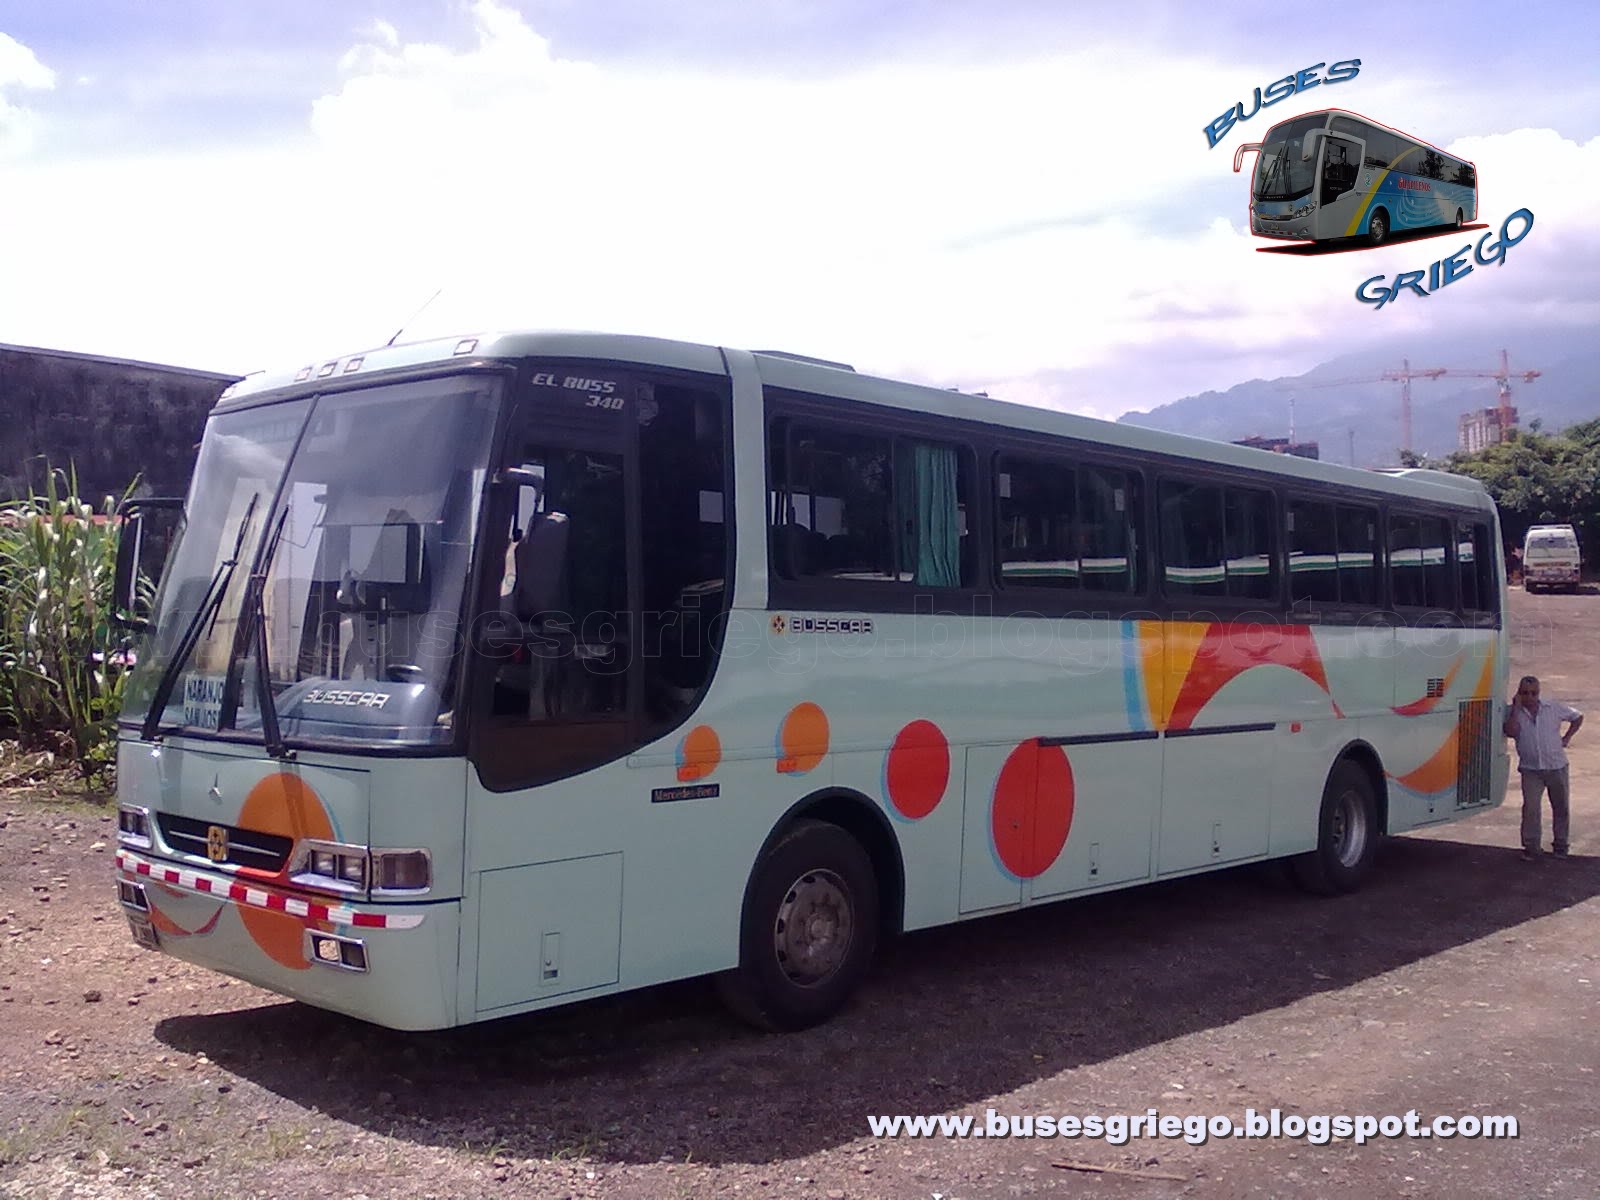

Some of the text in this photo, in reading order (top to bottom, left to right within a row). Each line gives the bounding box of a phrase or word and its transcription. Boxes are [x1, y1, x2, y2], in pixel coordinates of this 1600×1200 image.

[532, 372, 617, 393] EL BUSS
[585, 394, 625, 410] 340
[790, 617, 873, 634] BUSSCAR
